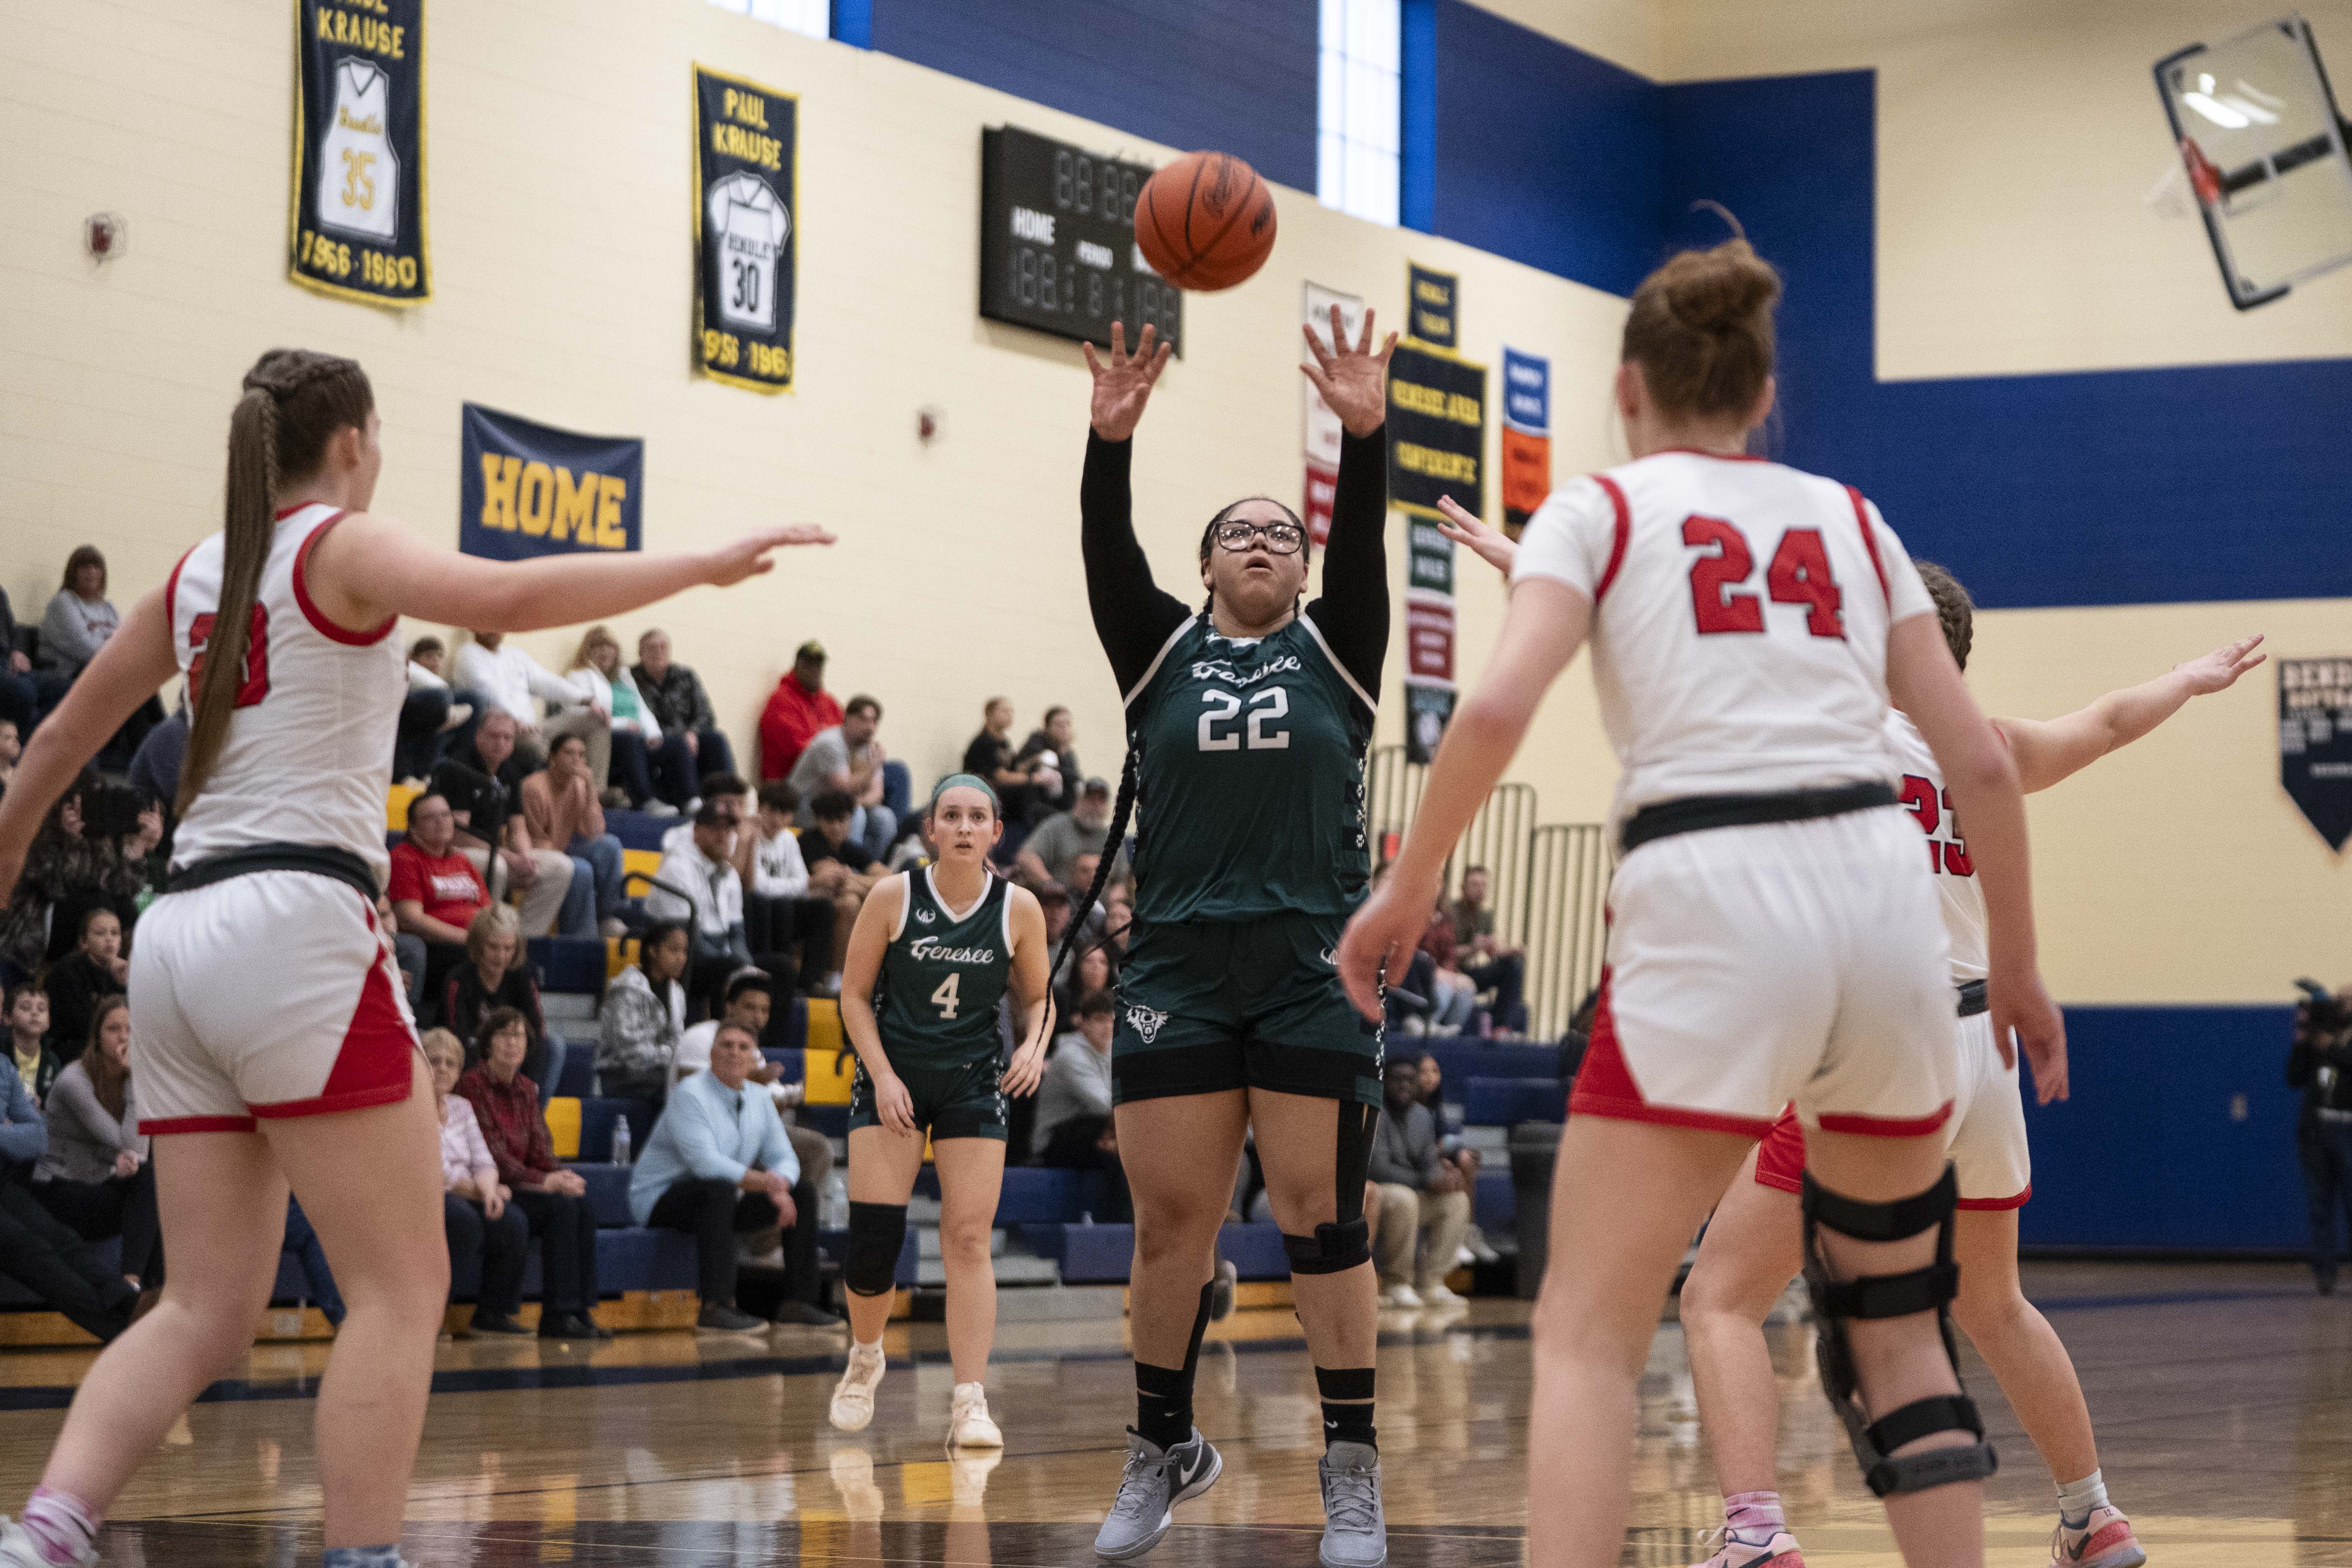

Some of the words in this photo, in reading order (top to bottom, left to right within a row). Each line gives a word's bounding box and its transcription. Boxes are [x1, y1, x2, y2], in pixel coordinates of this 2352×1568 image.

[317, 6, 404, 59] KRAUSE
[723, 88, 769, 130] PAUL
[712, 122, 782, 171] KRAUSE
[341, 147, 376, 210] 35
[1011, 205, 1056, 246] HOME
[733, 257, 760, 312] 30
[481, 451, 627, 549] HOME
[1681, 513, 1846, 638] 24
[1198, 686, 1290, 751] 22
[910, 936, 994, 964] Genesee
[931, 972, 960, 1019] 4
